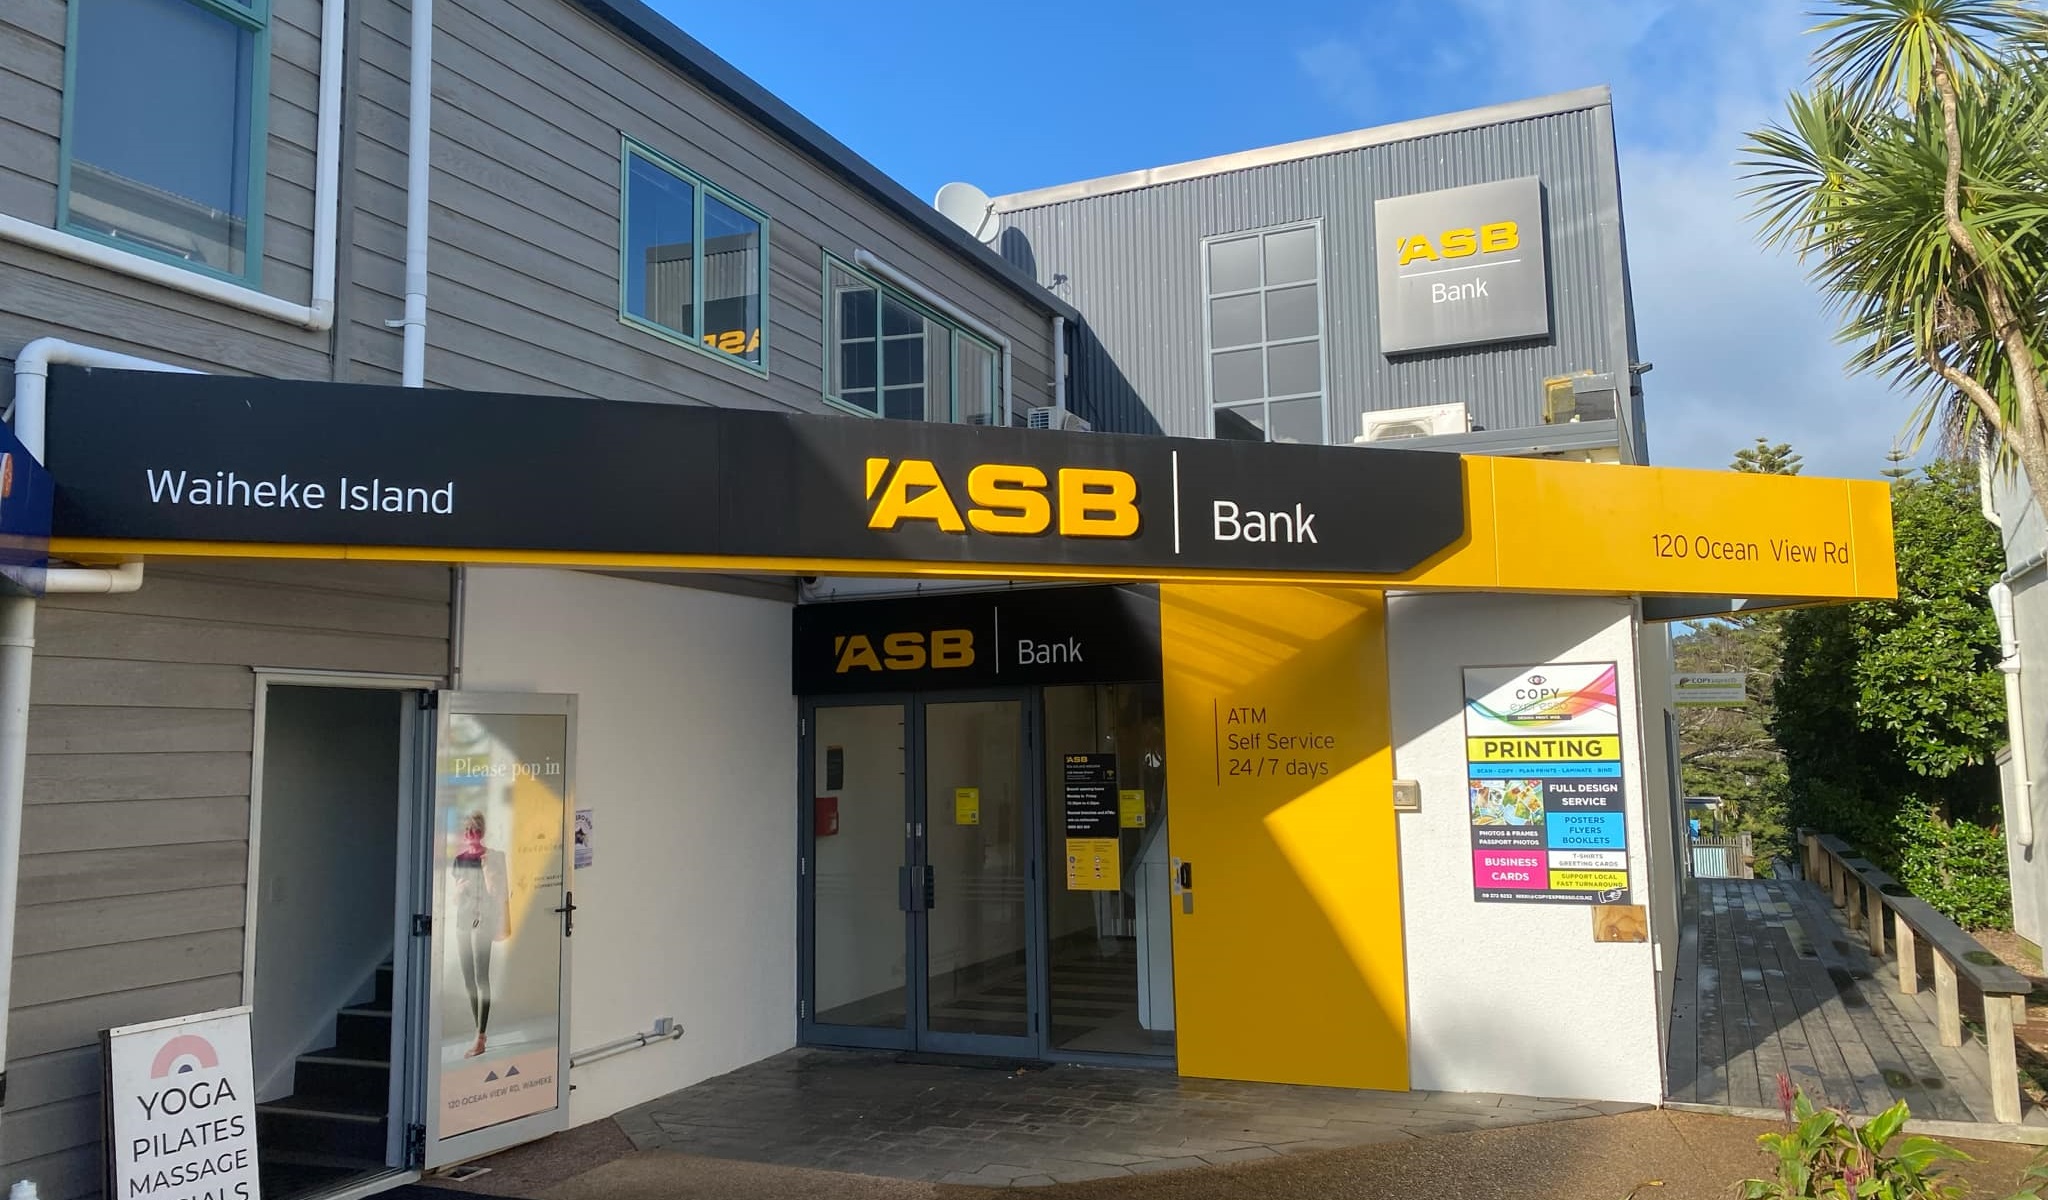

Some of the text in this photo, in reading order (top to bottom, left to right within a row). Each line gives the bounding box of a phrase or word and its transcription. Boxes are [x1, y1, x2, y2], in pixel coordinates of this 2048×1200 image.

[1396, 221, 1519, 265] ASB
[1432, 277, 1489, 304] Bank
[146, 469, 454, 514] Waiheke Island
[866, 457, 1318, 543] ASB Bank
[1652, 534, 1849, 564] 120 Ocean View Rd
[834, 629, 1084, 674] ASB Bank
[1515, 688, 1560, 700] COPY
[1227, 707, 1267, 724] ATM
[1510, 702, 1568, 712] expresso
[1228, 732, 1335, 750] Self Service
[1484, 740, 1602, 758] PRINTING
[454, 757, 560, 781] Please pop in
[1286, 759, 1329, 780] days
[1549, 783, 1618, 793] FULL DESIGN
[1561, 797, 1607, 806] SERVICE
[1564, 816, 1605, 824] POSTERS
[1484, 858, 1538, 867] BUSINESS
[1491, 872, 1530, 881] CARDS
[137, 1077, 237, 1121] YOGA
[461, 1093, 488, 1105] OCEAN
[489, 1087, 508, 1098] VIEW
[522, 1075, 553, 1089] WAIHEKE
[133, 1115, 245, 1163] PILATES
[129, 1148, 249, 1198] MASSAGE
